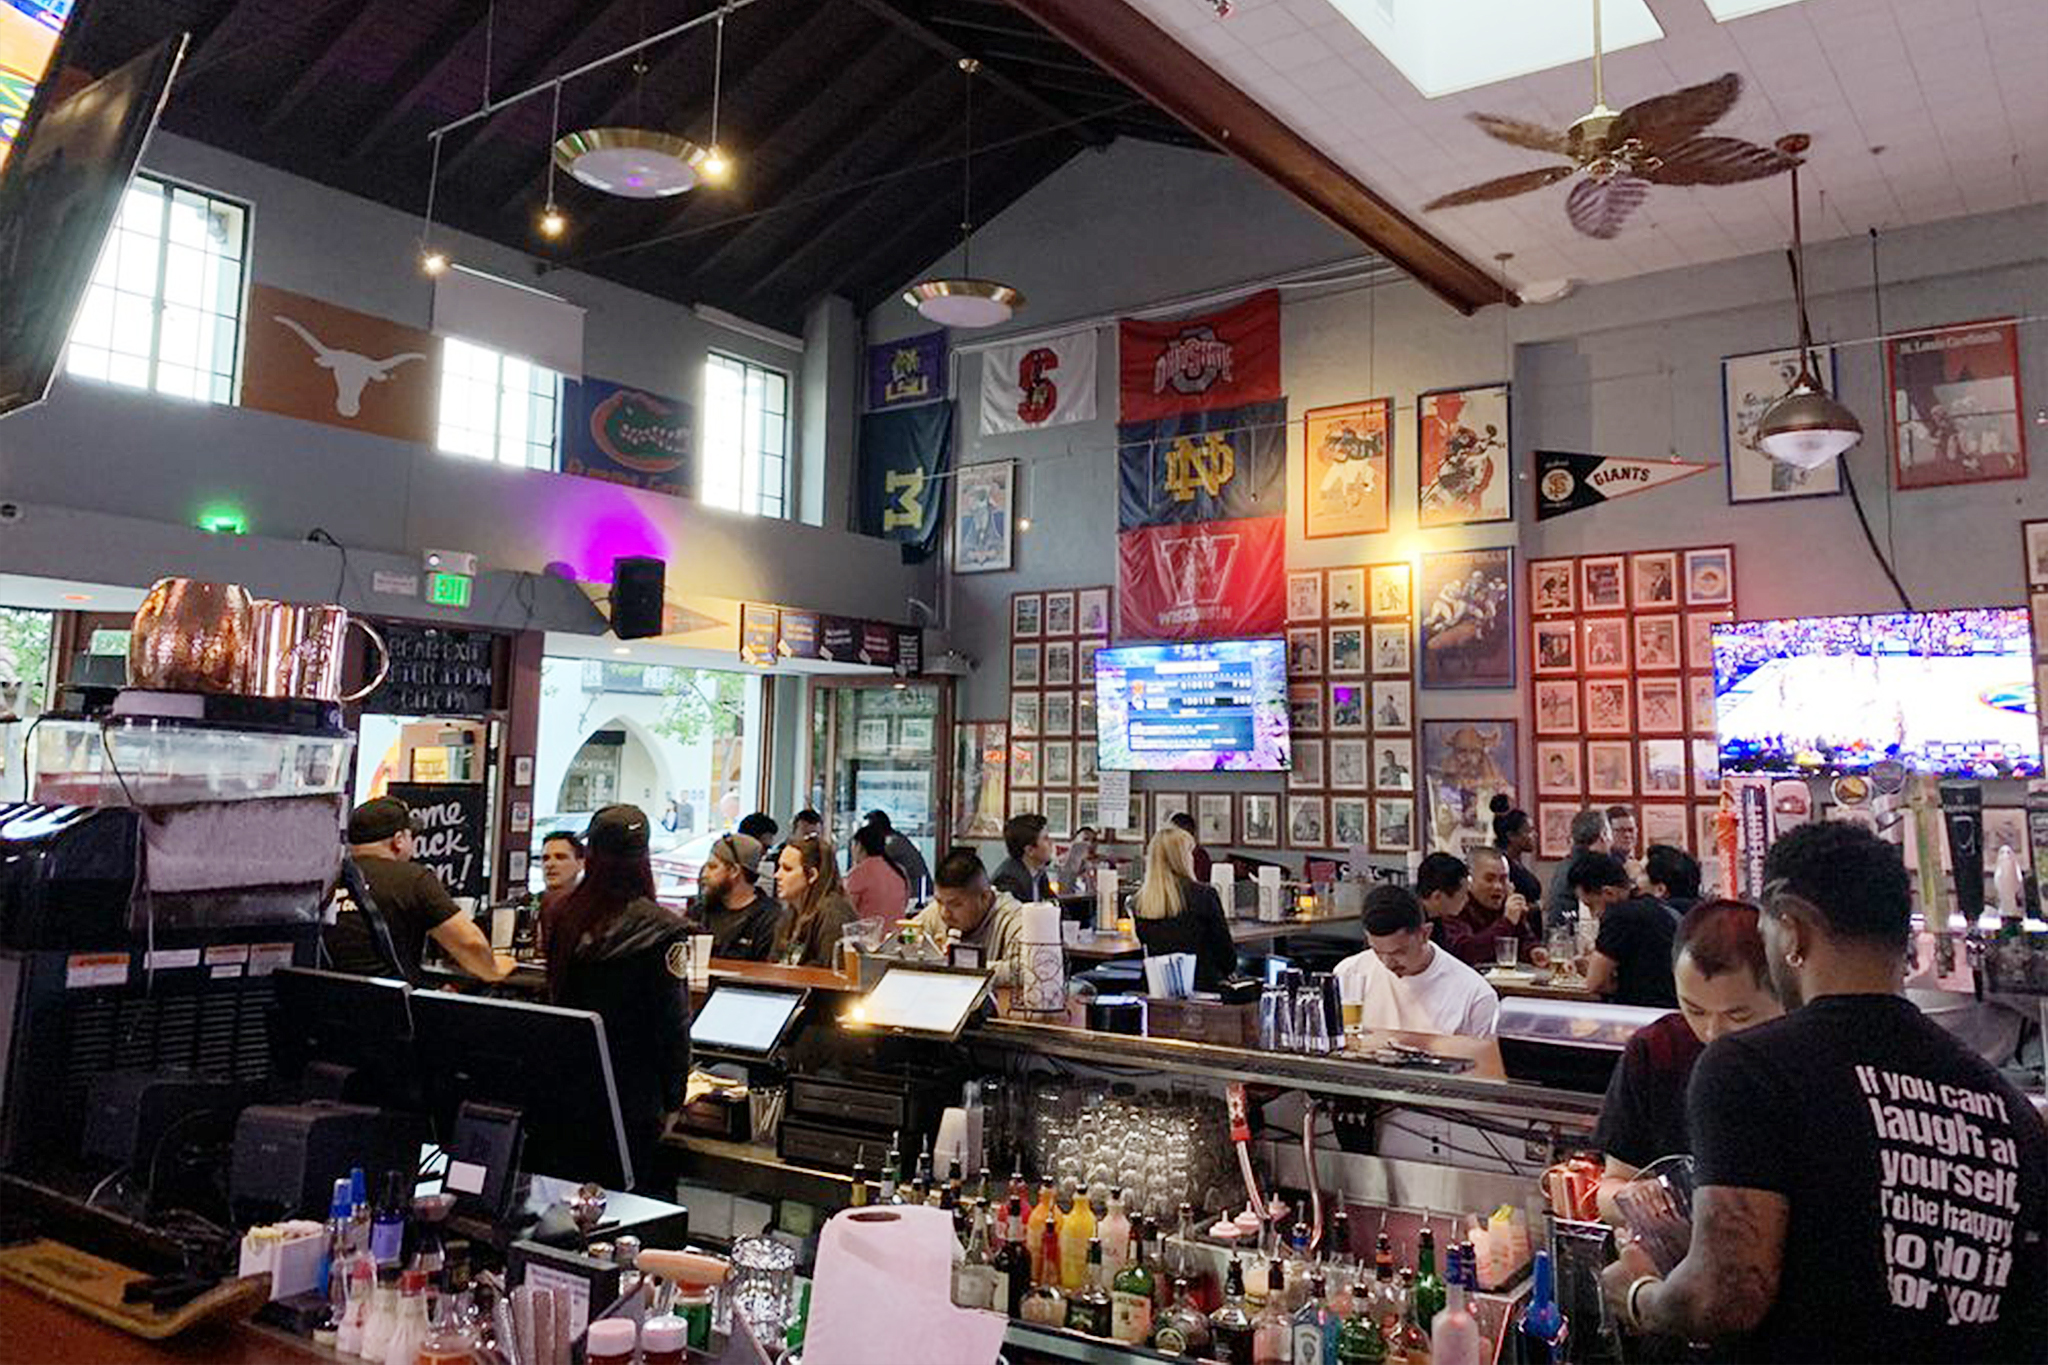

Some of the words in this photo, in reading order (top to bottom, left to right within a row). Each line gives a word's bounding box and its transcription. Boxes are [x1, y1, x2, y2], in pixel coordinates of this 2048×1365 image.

[1593, 467, 1651, 487] GIANTS
[408, 801, 467, 830] ome
[413, 829, 470, 859] ack
[1855, 1065, 1880, 1095] If
[1882, 1071, 1937, 1105] you
[1939, 1084, 2011, 1125] can't
[1868, 1097, 1986, 1159] laugh
[1990, 1138, 2019, 1169] at
[1880, 1149, 2021, 1214] yourself,
[1881, 1189, 1910, 1221] I'd
[1912, 1193, 1940, 1227] be
[1943, 1199, 2015, 1248] happy
[1882, 1223, 1927, 1270] to
[1933, 1236, 1982, 1281] do
[1983, 1246, 2014, 1288] it
[1887, 1266, 1938, 1310] for
[1943, 1284, 2001, 1325] you
